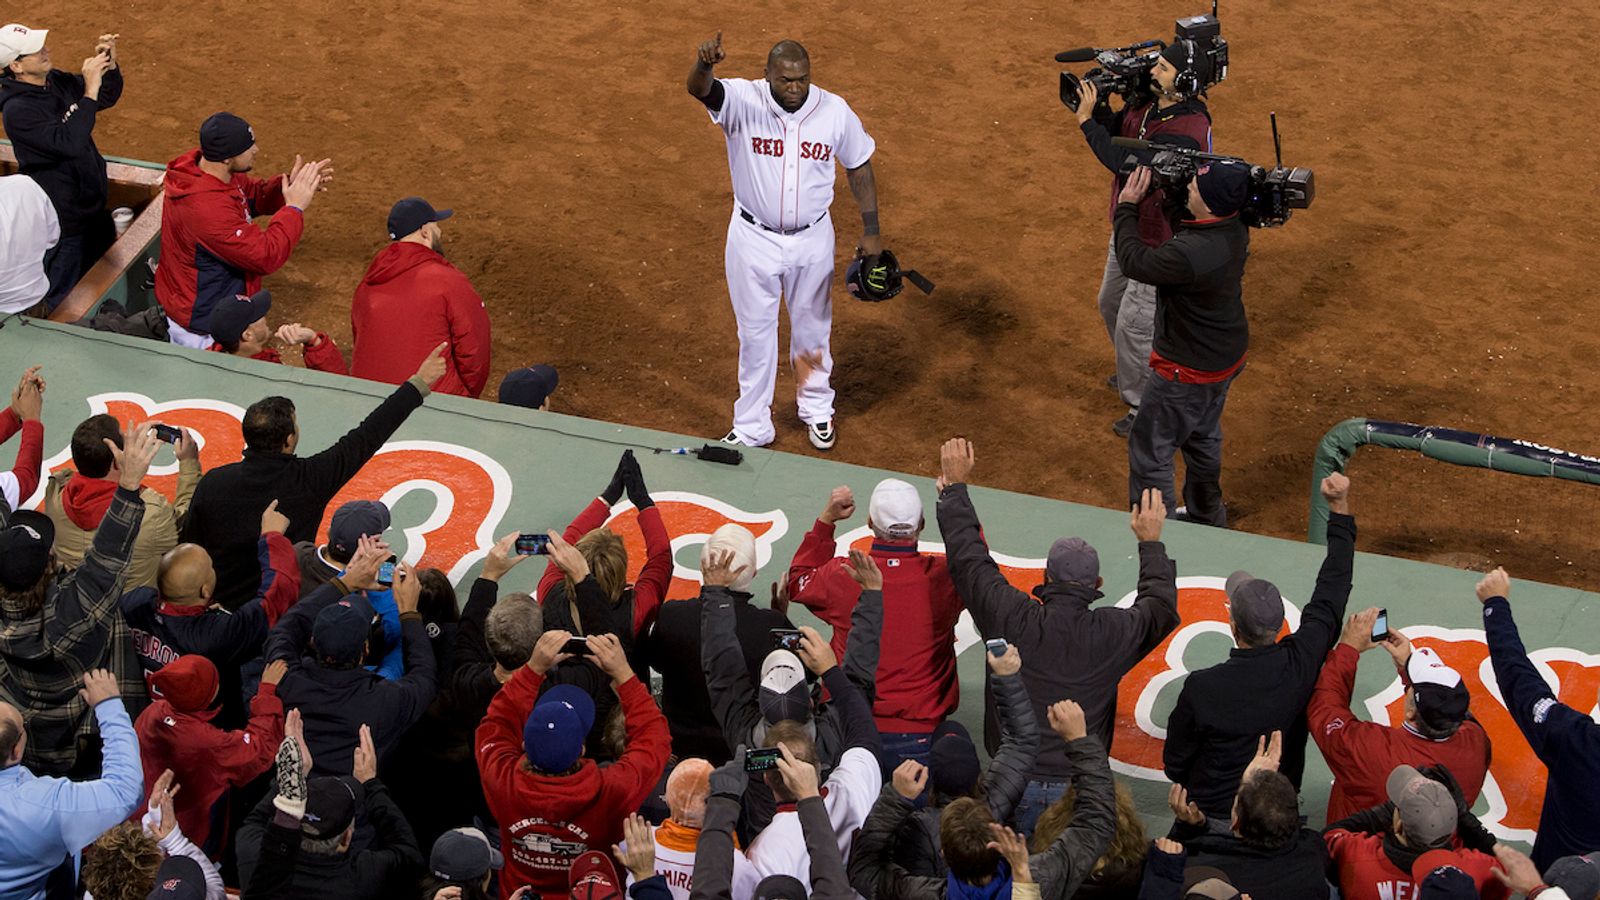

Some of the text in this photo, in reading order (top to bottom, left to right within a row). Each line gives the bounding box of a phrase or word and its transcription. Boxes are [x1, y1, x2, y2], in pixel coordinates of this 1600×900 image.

[752, 137, 833, 162] RED SOX
[567, 823, 589, 840] CAB
